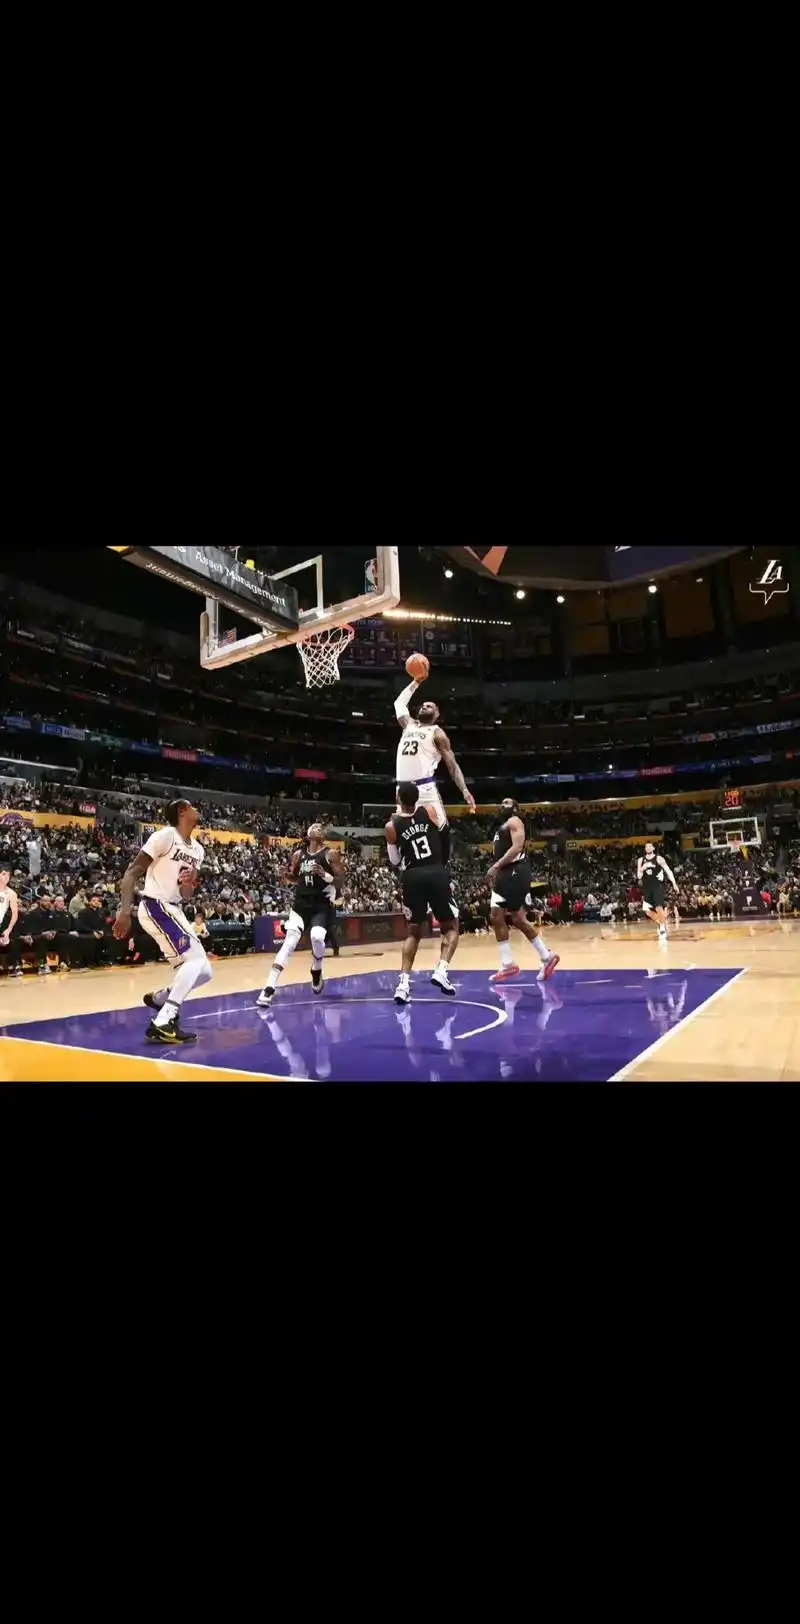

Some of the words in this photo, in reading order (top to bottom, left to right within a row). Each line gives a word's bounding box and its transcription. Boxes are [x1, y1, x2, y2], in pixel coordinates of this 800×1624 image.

[195, 551, 223, 573] Asset
[224, 566, 286, 607] Management
[402, 741, 418, 756] 23
[411, 835, 432, 860] 13
[304, 875, 314, 887] 14
